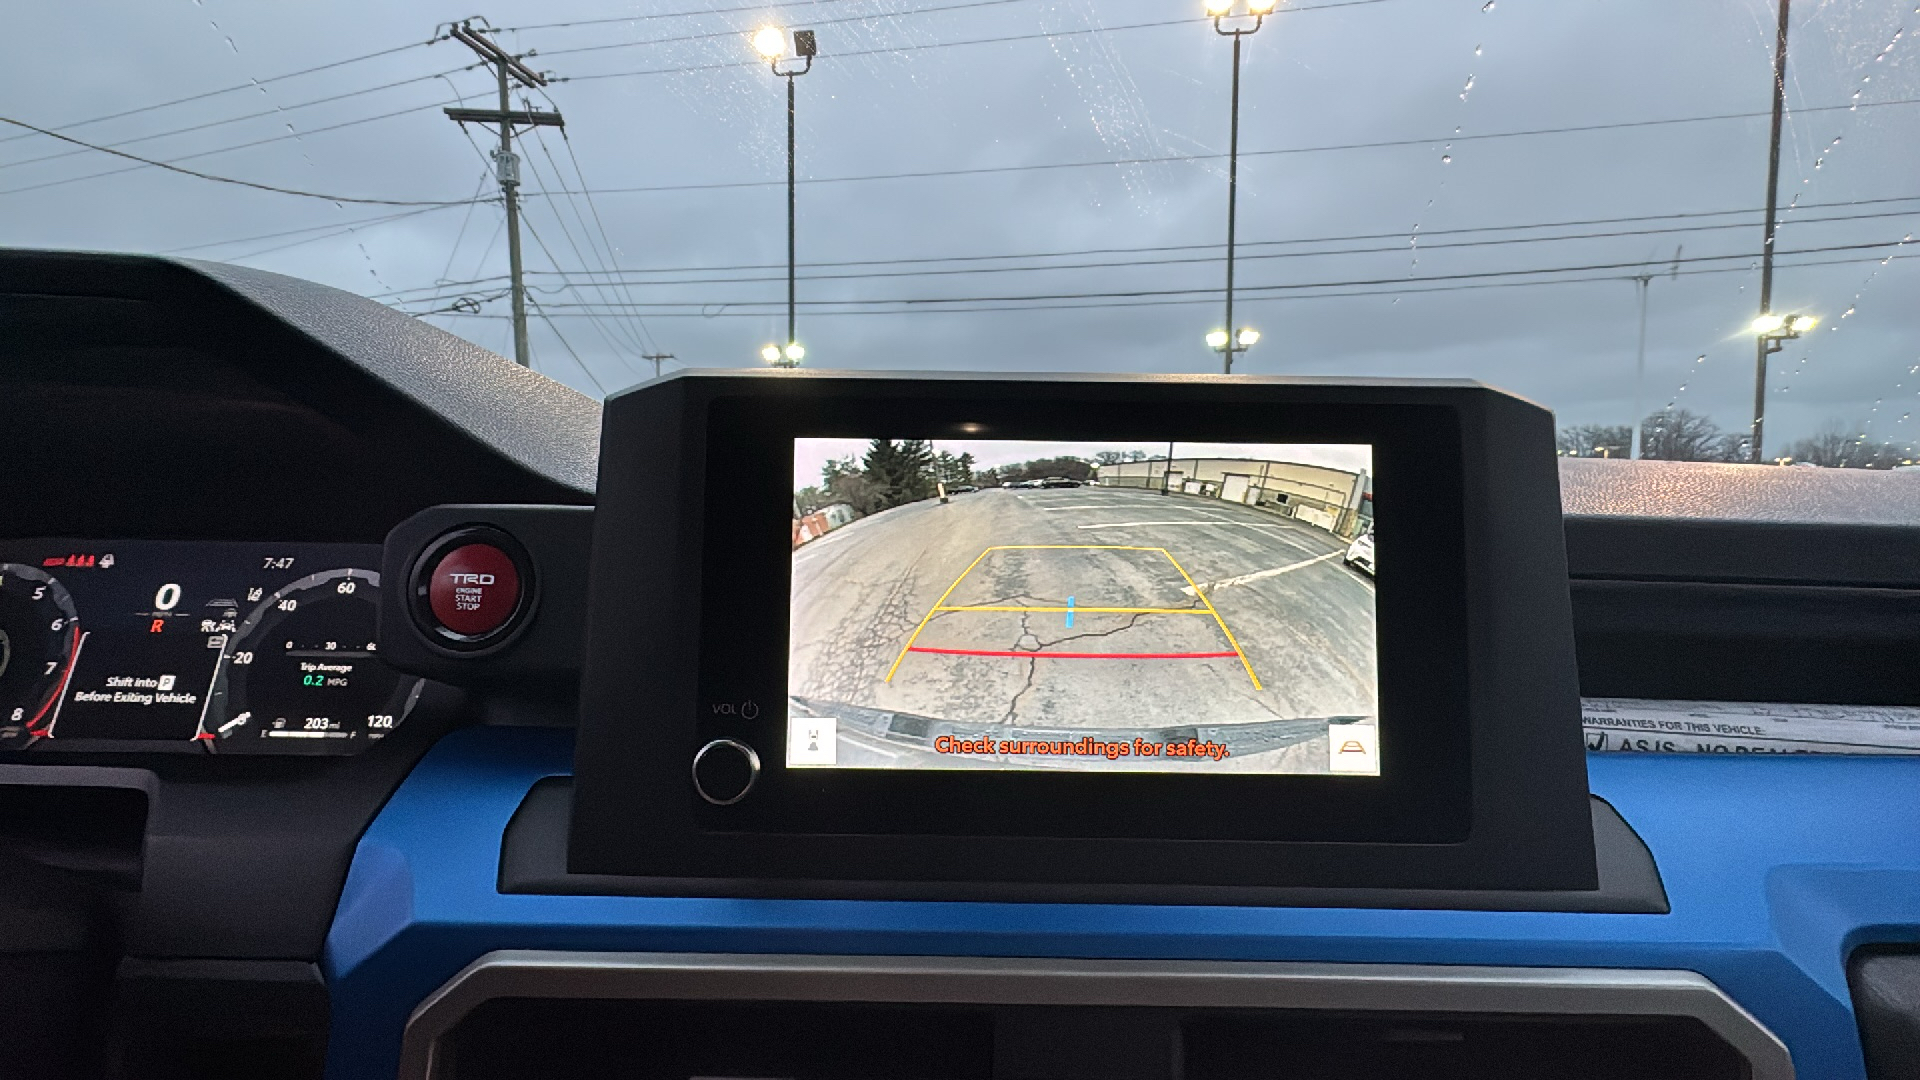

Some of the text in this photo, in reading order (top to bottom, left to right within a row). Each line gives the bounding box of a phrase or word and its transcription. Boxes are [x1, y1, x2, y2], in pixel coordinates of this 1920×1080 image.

[263, 557, 294, 569] 7:47
[449, 573, 495, 585] TRD
[32, 586, 46, 600] 5
[337, 582, 355, 594] 60
[455, 587, 483, 595] ENGINE
[155, 583, 181, 611] 0
[455, 594, 483, 603] START
[278, 599, 297, 611] 40
[455, 602, 481, 611] STOP
[51, 619, 63, 631] 6
[150, 619, 165, 633] R
[325, 641, 337, 651] 30
[233, 652, 253, 665] 20
[43, 661, 58, 675] 7
[300, 661, 353, 674] Trip Average
[105, 676, 134, 688] Shift
[134, 678, 158, 688] into
[303, 675, 348, 687] 0.2 MPG
[74, 691, 197, 706] Before Exiting Vehicle
[11, 708, 24, 721] 8
[712, 703, 737, 715] VOL
[303, 717, 329, 730] 203
[367, 715, 392, 729] 120
[1658, 721, 1683, 731] FOR
[1684, 722, 1711, 733] THIS
[935, 735, 1230, 761] Check surroundings for safety.
[1620, 738, 1649, 752] AS
